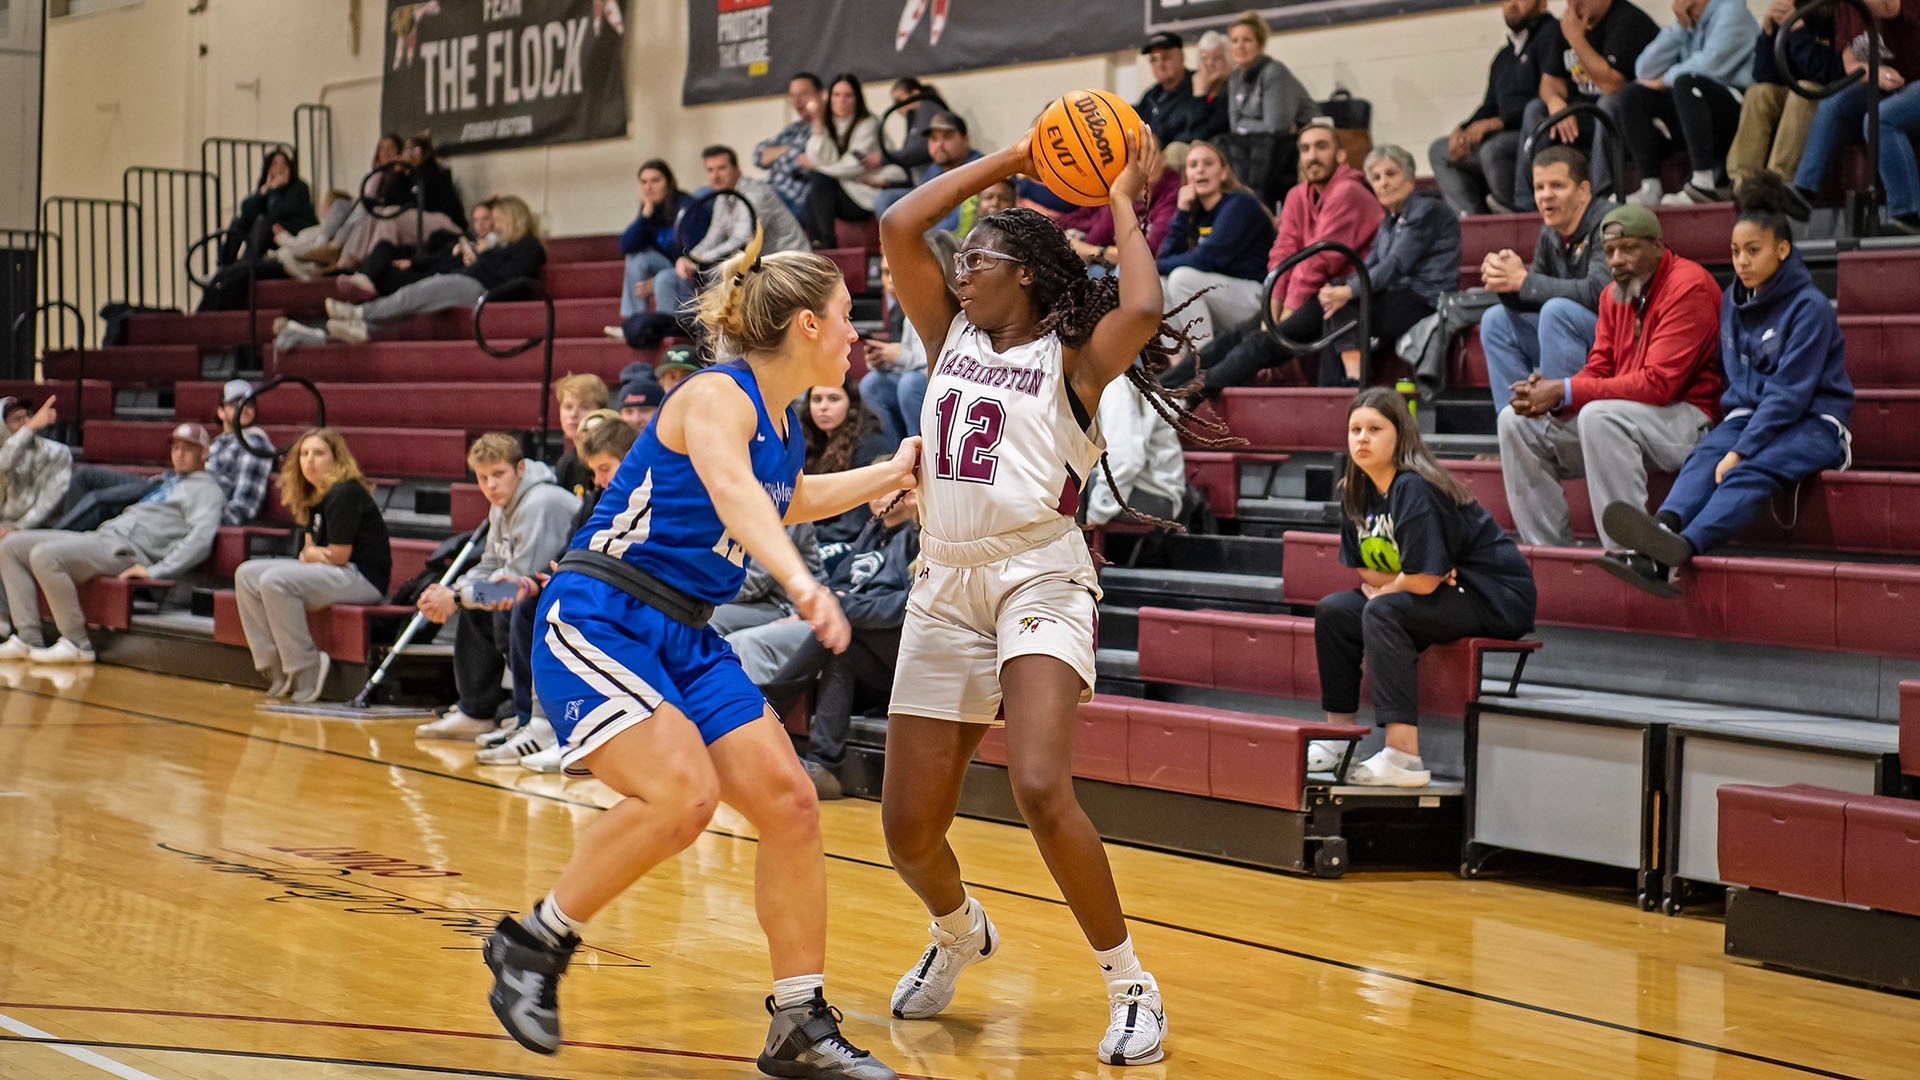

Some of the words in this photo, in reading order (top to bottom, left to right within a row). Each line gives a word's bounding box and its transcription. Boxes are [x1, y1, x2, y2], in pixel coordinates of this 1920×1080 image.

[420, 34, 479, 115] THE
[486, 16, 589, 108] FLOCK
[1075, 96, 1114, 168] Wilson
[936, 388, 1007, 486] 12
